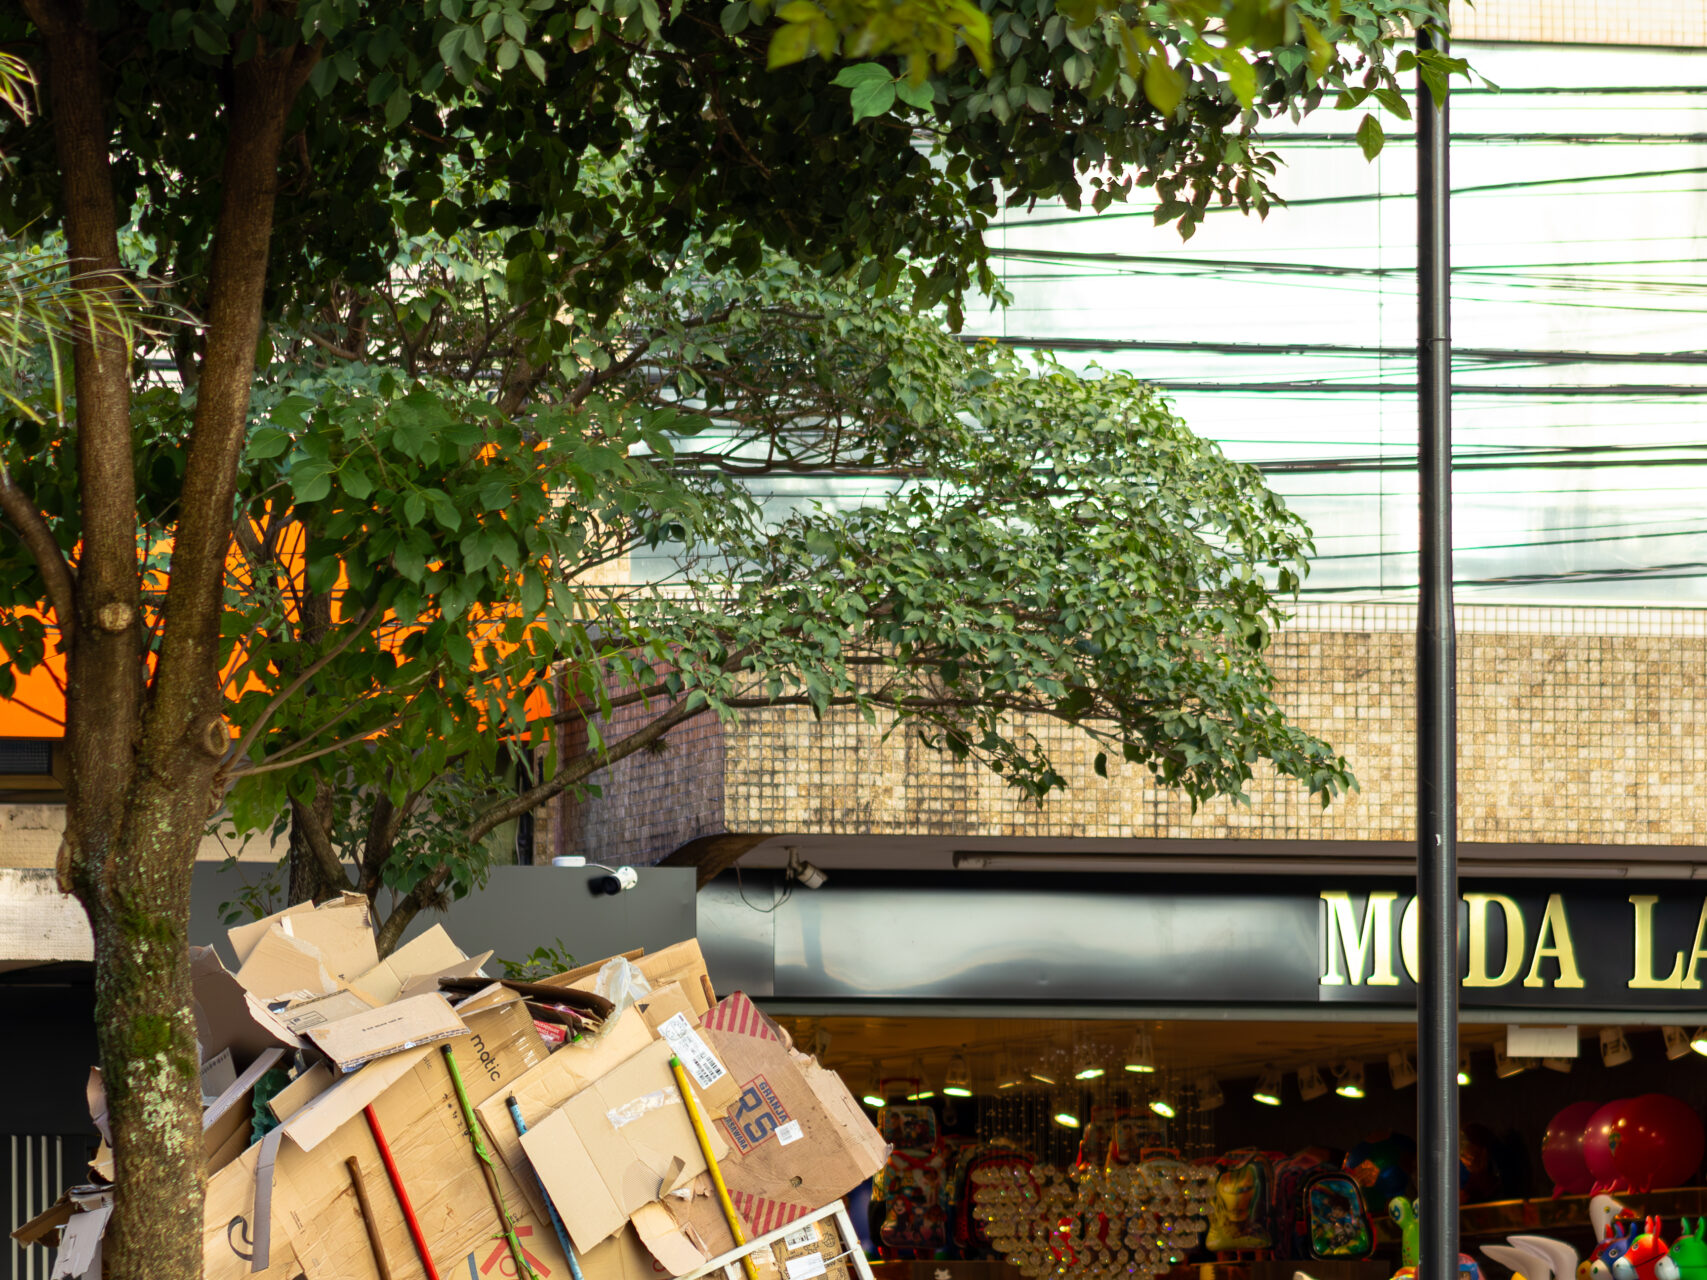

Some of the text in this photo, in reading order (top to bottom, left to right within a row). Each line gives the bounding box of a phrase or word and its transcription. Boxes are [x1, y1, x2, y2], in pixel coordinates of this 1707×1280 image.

[470, 1034, 501, 1082] matic
[735, 1087, 778, 1144] RS
[759, 1081, 788, 1123] GRANJA
